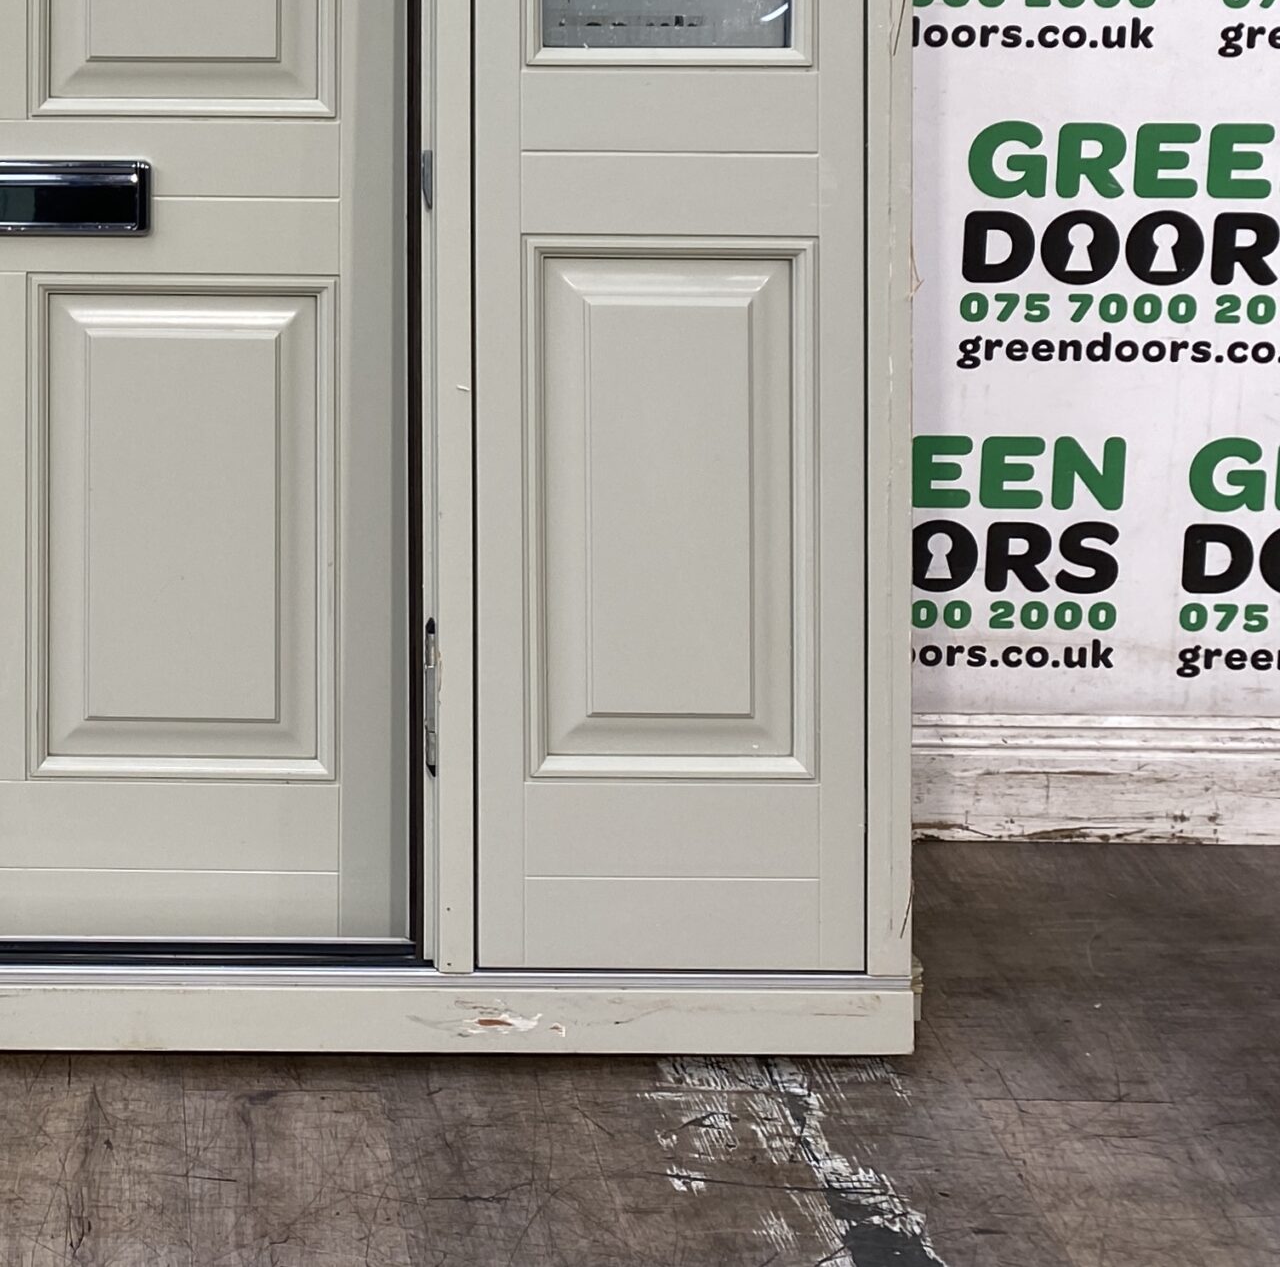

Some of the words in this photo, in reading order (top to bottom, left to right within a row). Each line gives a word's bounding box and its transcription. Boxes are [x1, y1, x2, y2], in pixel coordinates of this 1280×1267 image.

[968, 121, 1274, 199] GREE
[962, 210, 1280, 286] DOOR
[960, 293, 1049, 322] 075
[1069, 294, 1196, 323] 7000
[1215, 295, 1275, 324] 20
[1189, 438, 1280, 512] G
[1182, 524, 1280, 594] D
[989, 601, 1116, 630] 2000
[1180, 603, 1268, 632] 075
[912, 639, 1113, 668] ors.co.uk
[1177, 645, 1280, 677] gree
